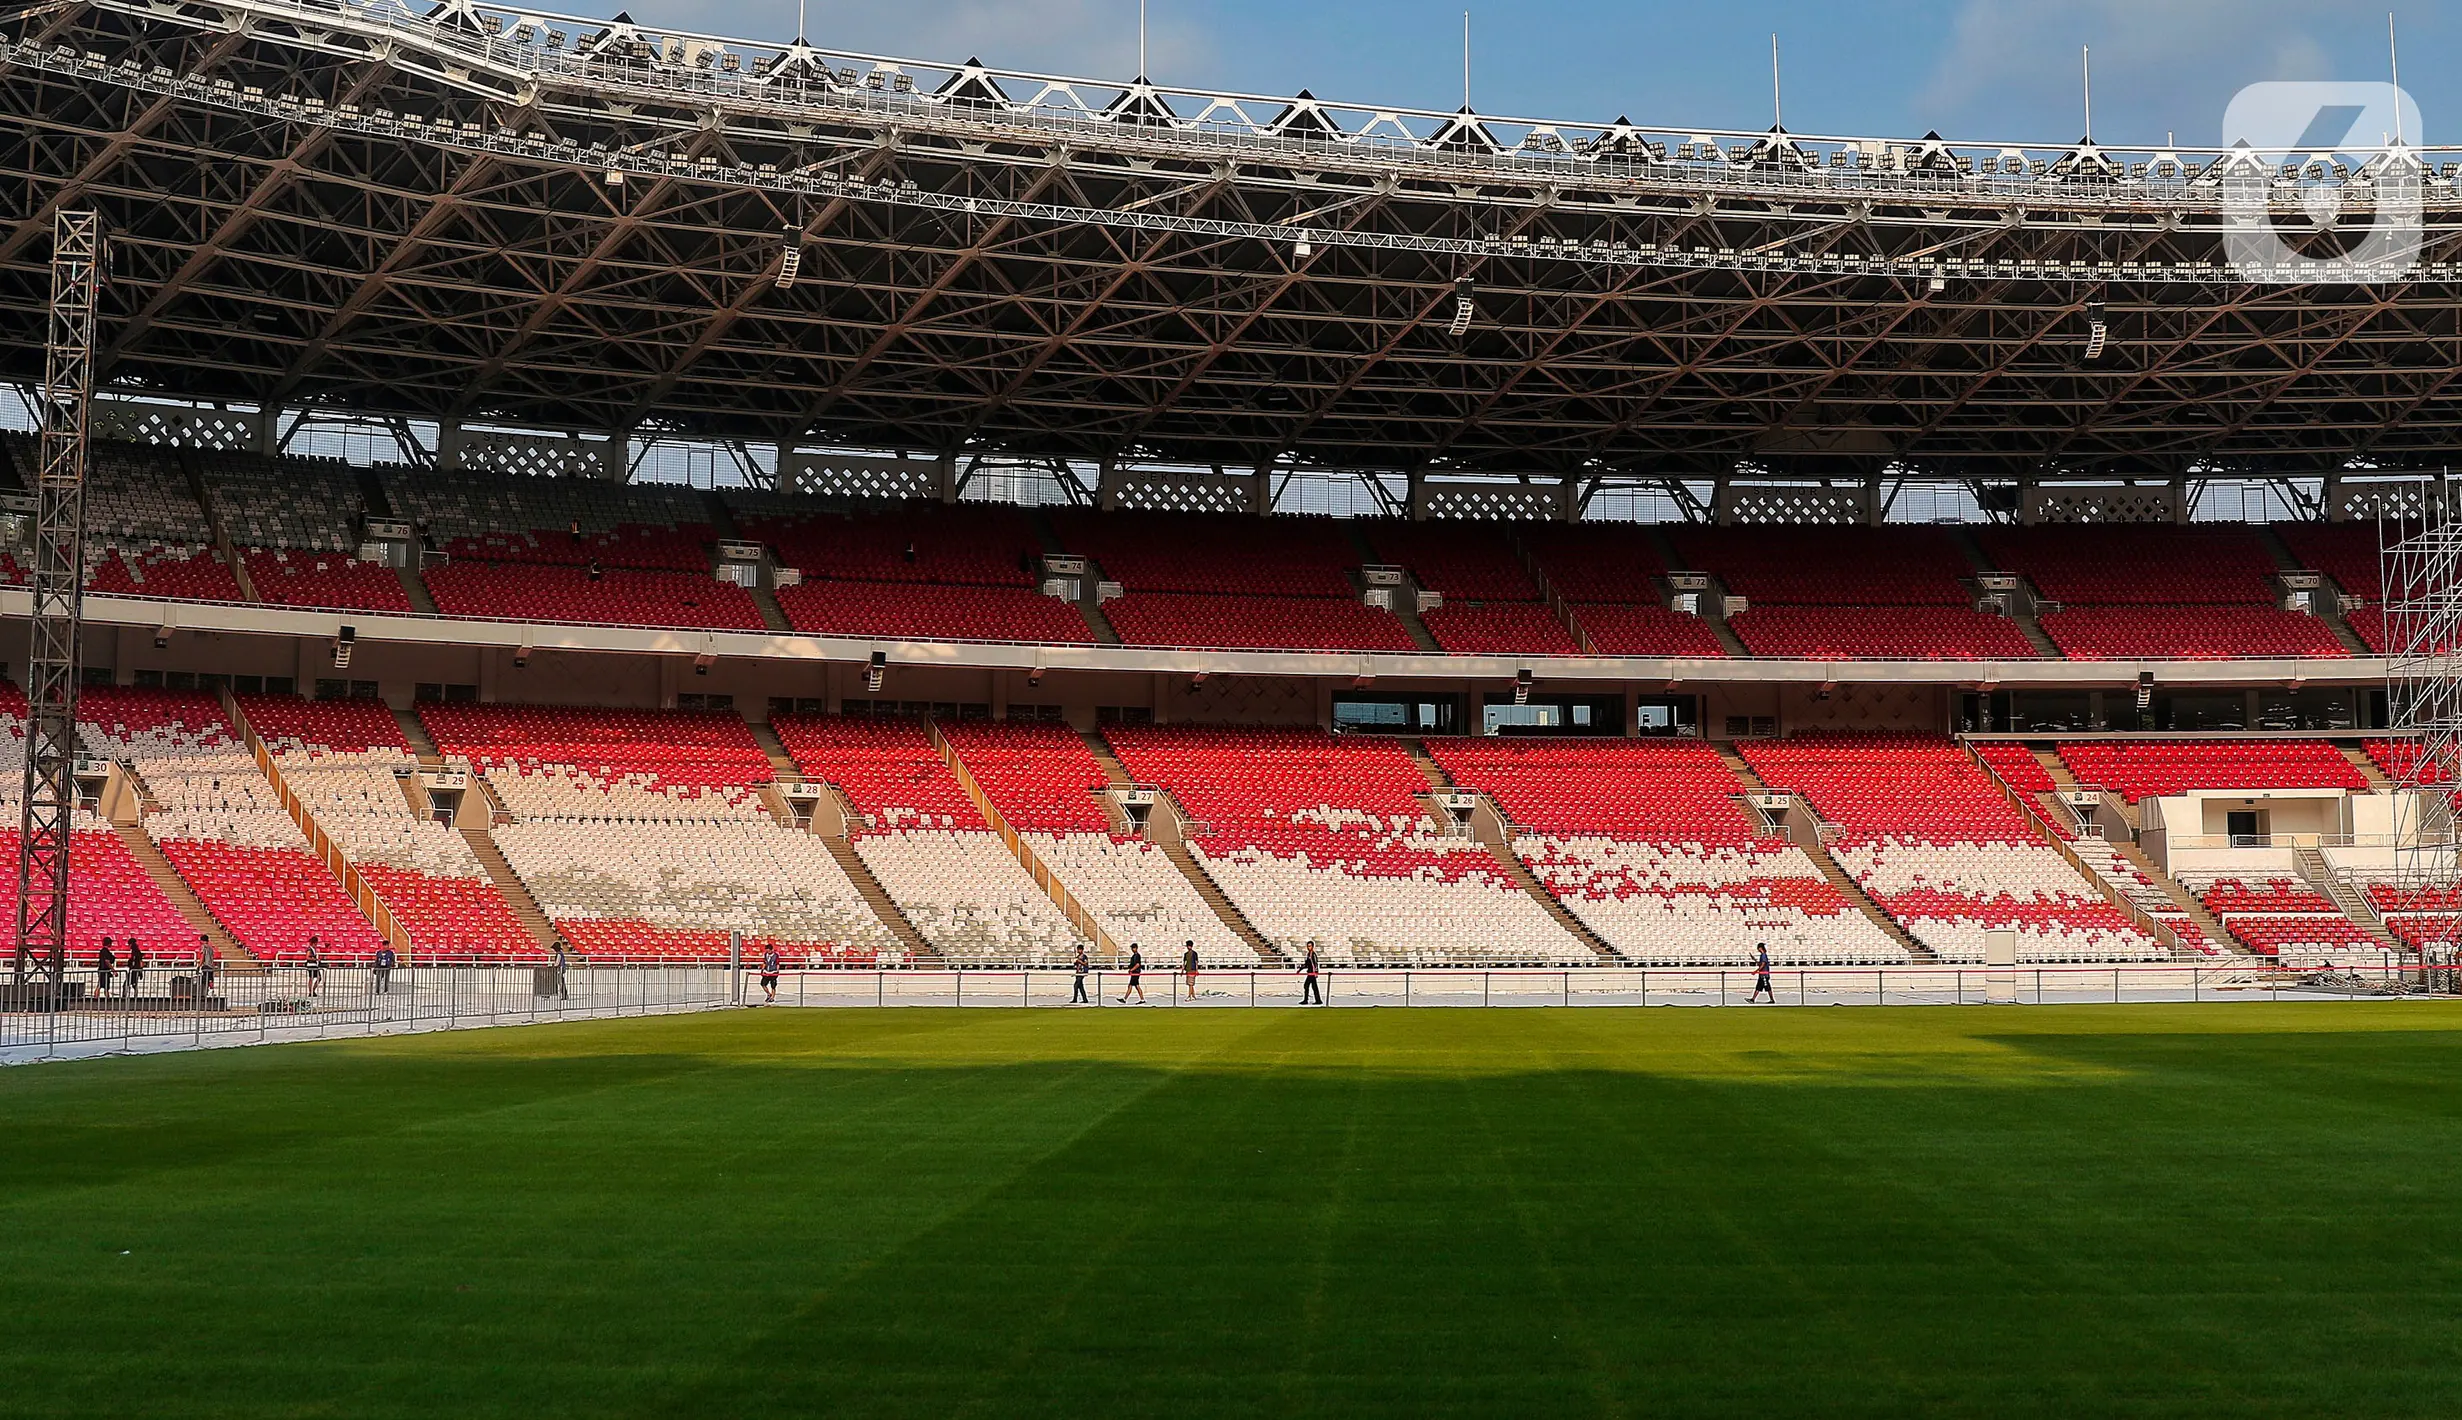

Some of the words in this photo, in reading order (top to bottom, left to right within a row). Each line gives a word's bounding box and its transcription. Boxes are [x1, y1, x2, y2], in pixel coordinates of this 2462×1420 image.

[483, 432, 556, 446] SEKTOR
[572, 440, 585, 448] 10
[1139, 472, 1205, 482] SEKTOR
[1222, 476, 1232, 484] 11
[2366, 481, 2434, 491] SEKTOR
[1753, 487, 1818, 496] SEKTOR
[1831, 488, 1842, 496] 12
[397, 526, 408, 535] 76
[748, 548, 759, 557] 75
[1071, 562, 1082, 571] 74
[1388, 572, 1399, 581] 73
[2307, 576, 2318, 585] 70
[1695, 578, 1706, 587] 72
[2005, 578, 2016, 587] 71
[94, 762, 107, 772] 30
[452, 776, 463, 785] 29
[806, 785, 818, 794] 28
[1141, 792, 1152, 801] 27
[1462, 796, 1473, 805] 26
[1777, 796, 1788, 805] 25
[2087, 793, 2097, 802] 24
